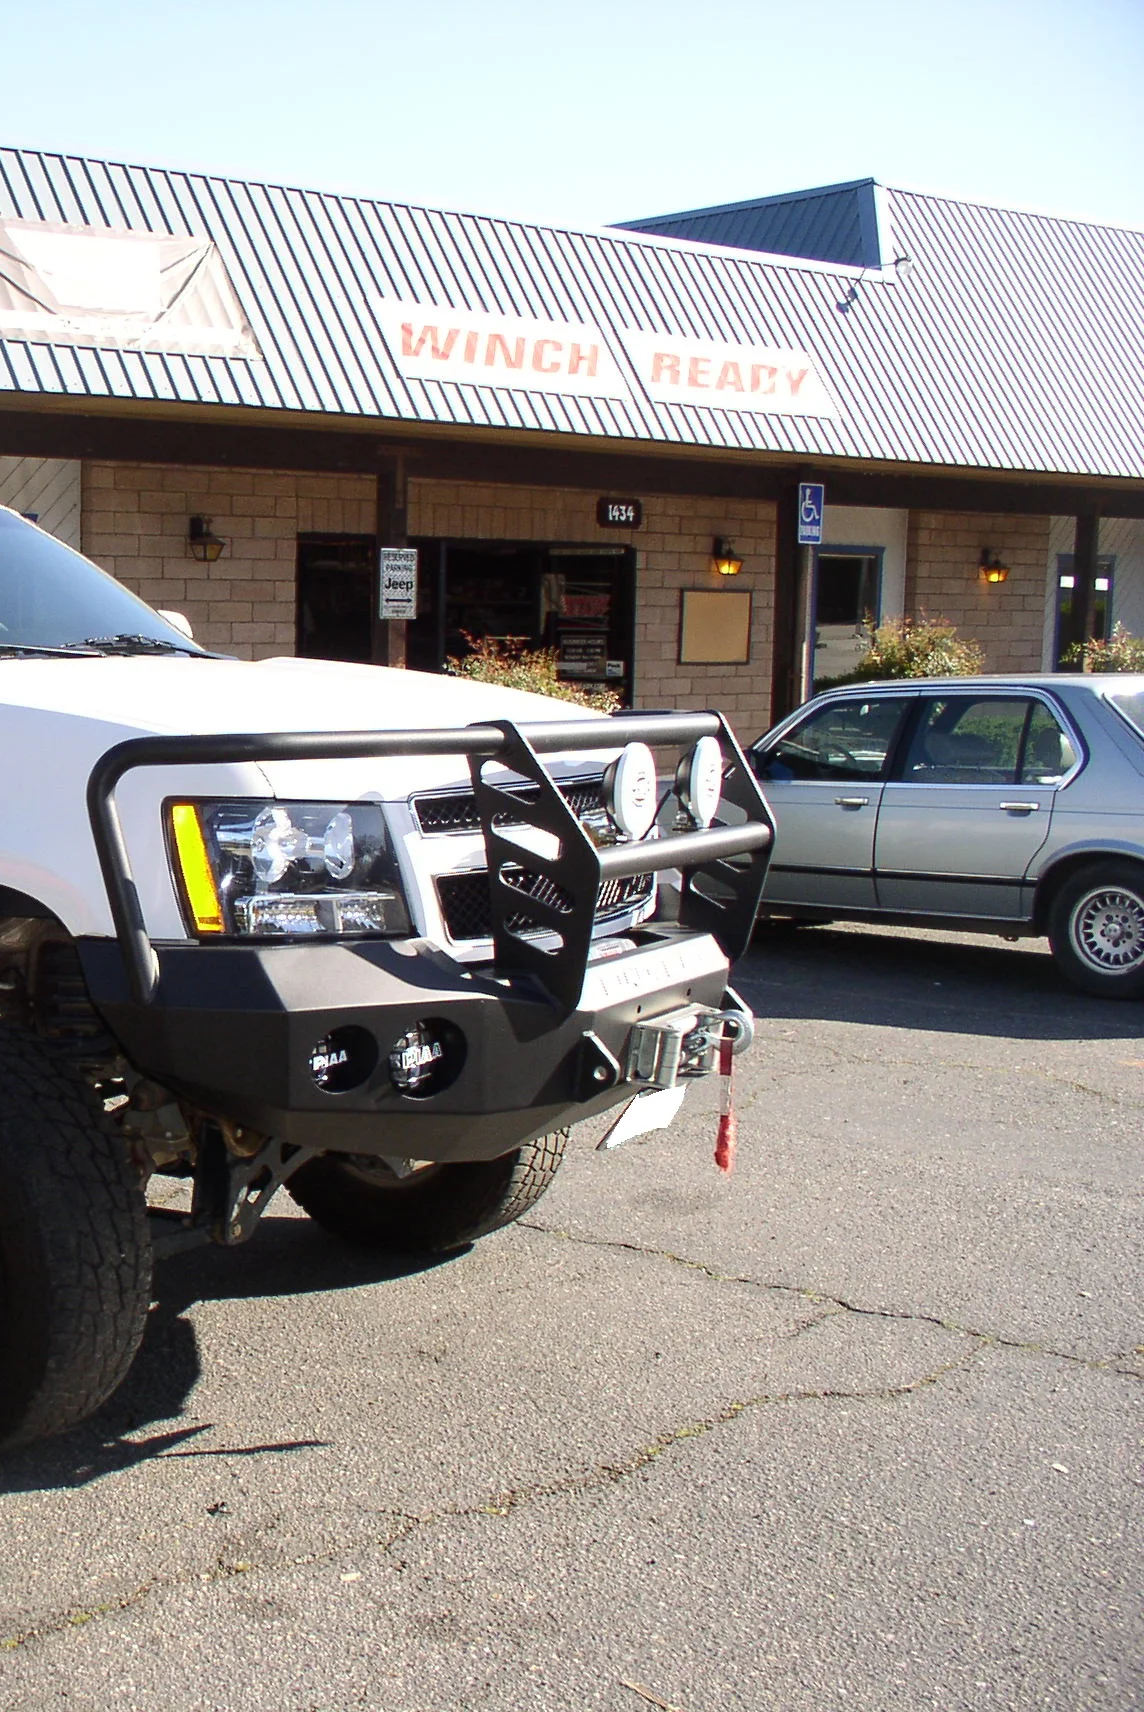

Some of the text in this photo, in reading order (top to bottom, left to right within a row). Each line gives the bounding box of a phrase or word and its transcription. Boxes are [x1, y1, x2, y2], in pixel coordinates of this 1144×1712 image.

[401, 321, 809, 398] WINCH READY
[608, 504, 634, 521] 1434
[383, 553, 415, 561] RESERVED
[385, 563, 414, 572] PARKING
[384, 577, 414, 592] Jeep
[312, 1049, 348, 1071] PIAA
[401, 1041, 444, 1070] PIAA
